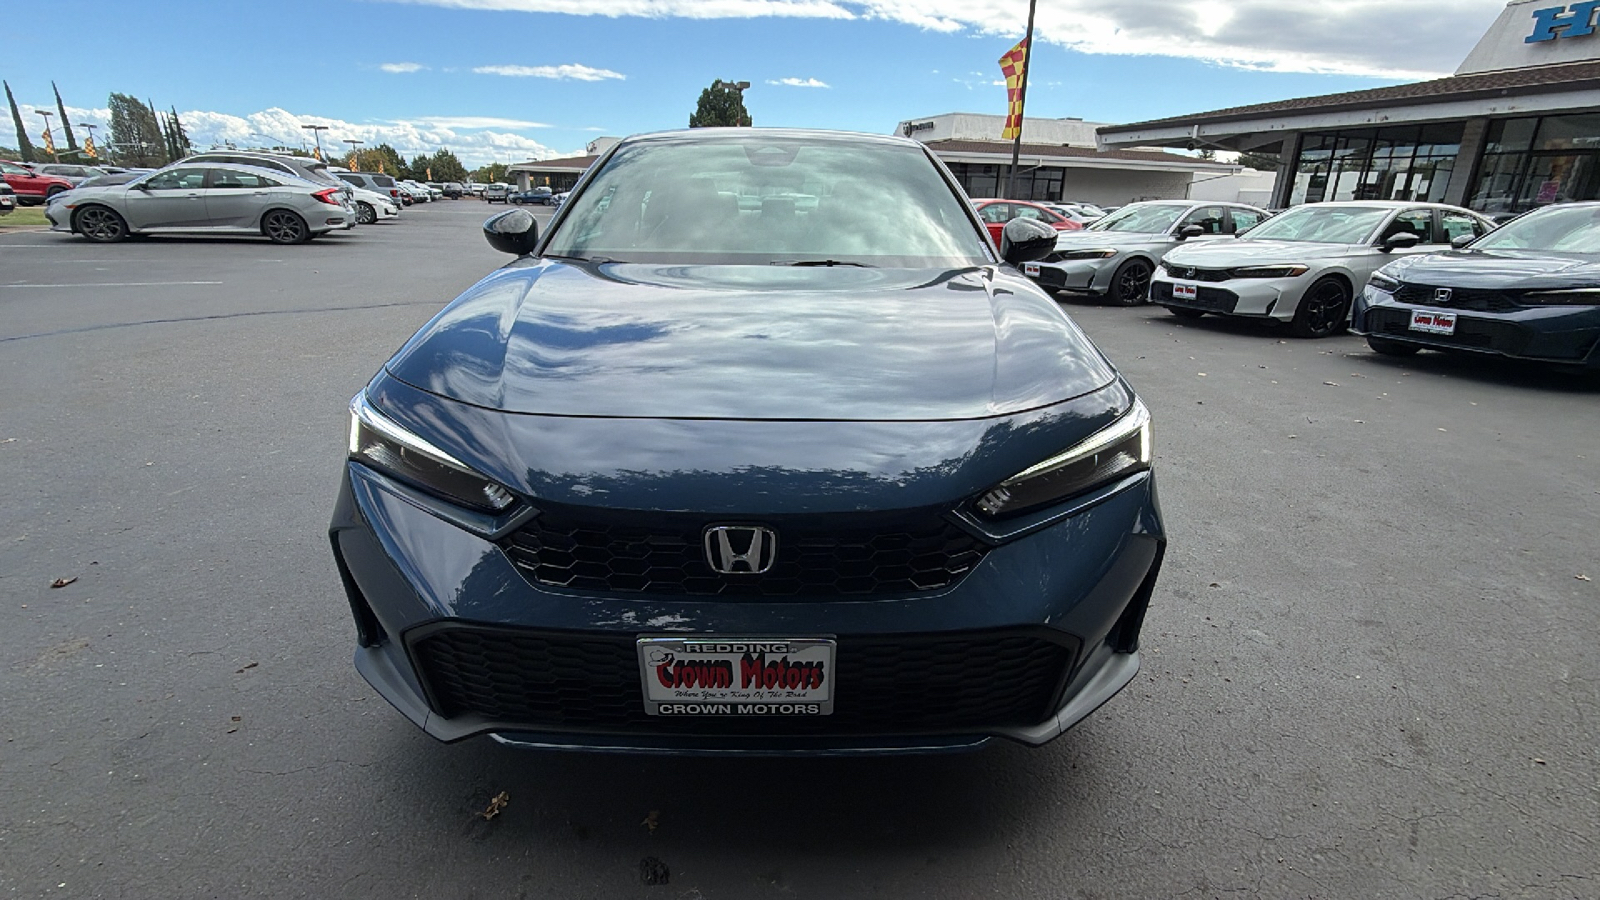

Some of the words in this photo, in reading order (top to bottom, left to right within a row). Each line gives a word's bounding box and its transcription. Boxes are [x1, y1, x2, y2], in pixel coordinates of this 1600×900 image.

[1524, 0, 1600, 44] H
[686, 644, 788, 653] REDDING
[656, 653, 734, 688] Crown
[740, 651, 825, 690] Motors
[730, 691, 751, 699] King
[753, 691, 765, 700] Of
[659, 704, 731, 714] CROWN
[737, 704, 819, 714] MOTORS
